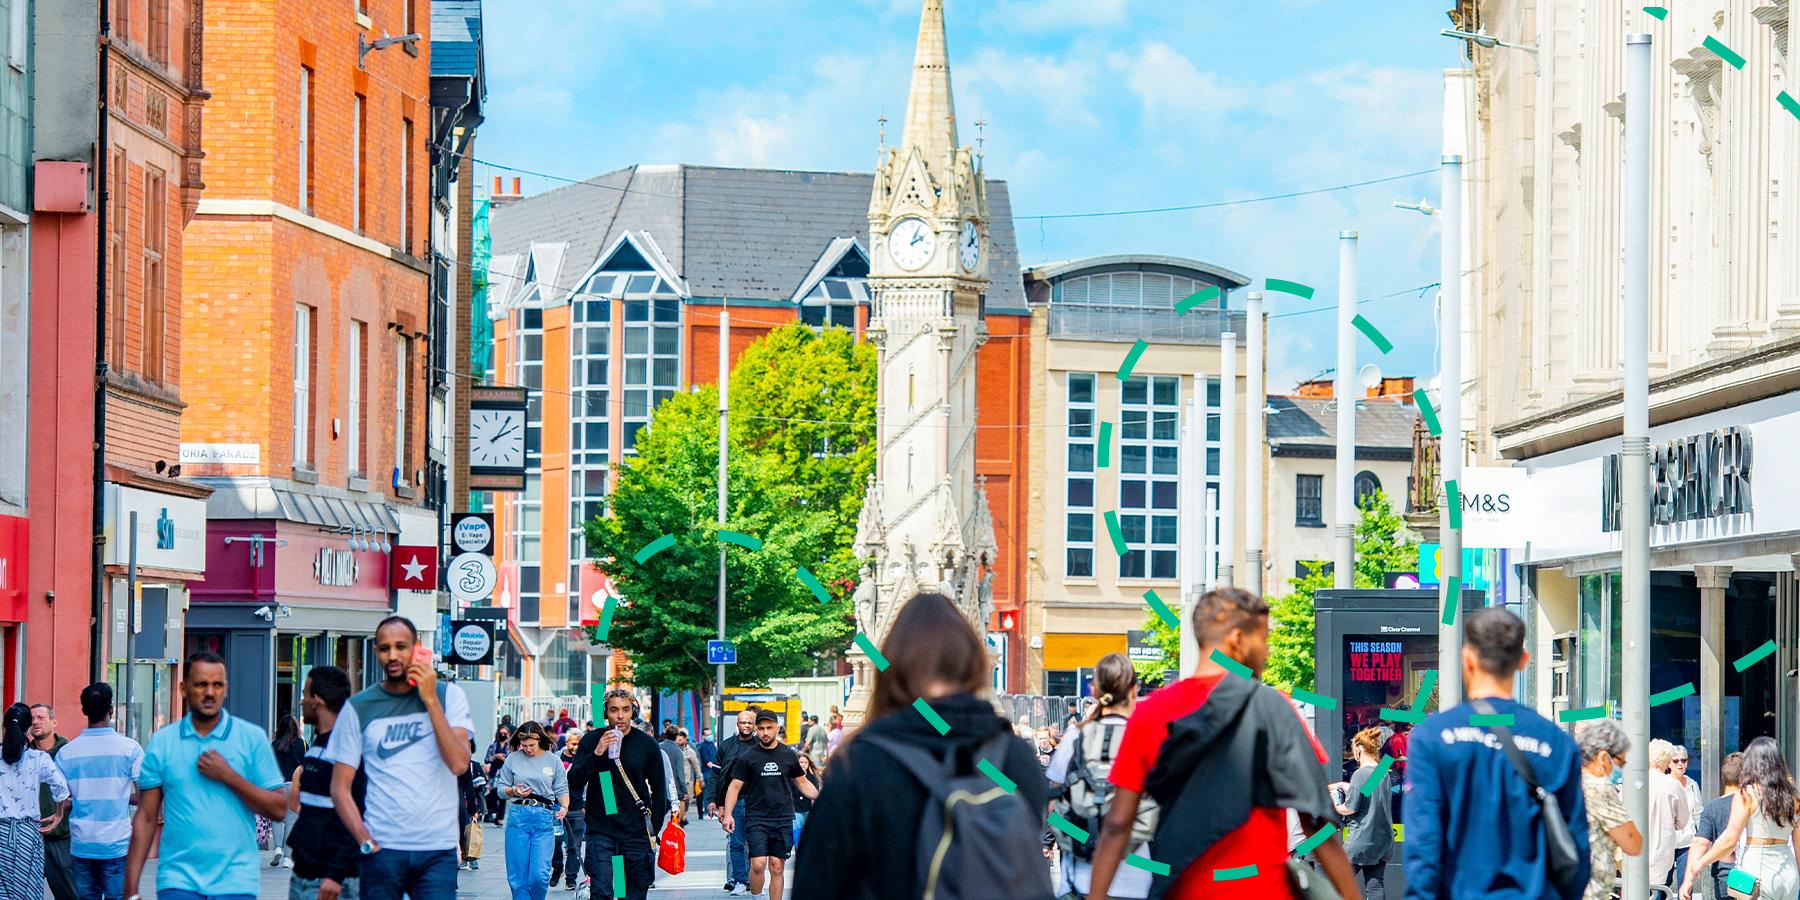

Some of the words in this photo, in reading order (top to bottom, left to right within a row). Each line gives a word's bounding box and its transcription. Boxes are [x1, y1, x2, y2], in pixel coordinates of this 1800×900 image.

[213, 449, 257, 459] PARADE
[1462, 493, 1510, 513] M&S
[459, 560, 486, 594] 3
[1350, 642, 1369, 653] THIS
[1370, 642, 1402, 653] SEASON
[1350, 653, 1369, 668] WE
[1371, 653, 1402, 668] PLAY
[1350, 667, 1403, 681] TOGETHER
[384, 721, 423, 744] NIKE
